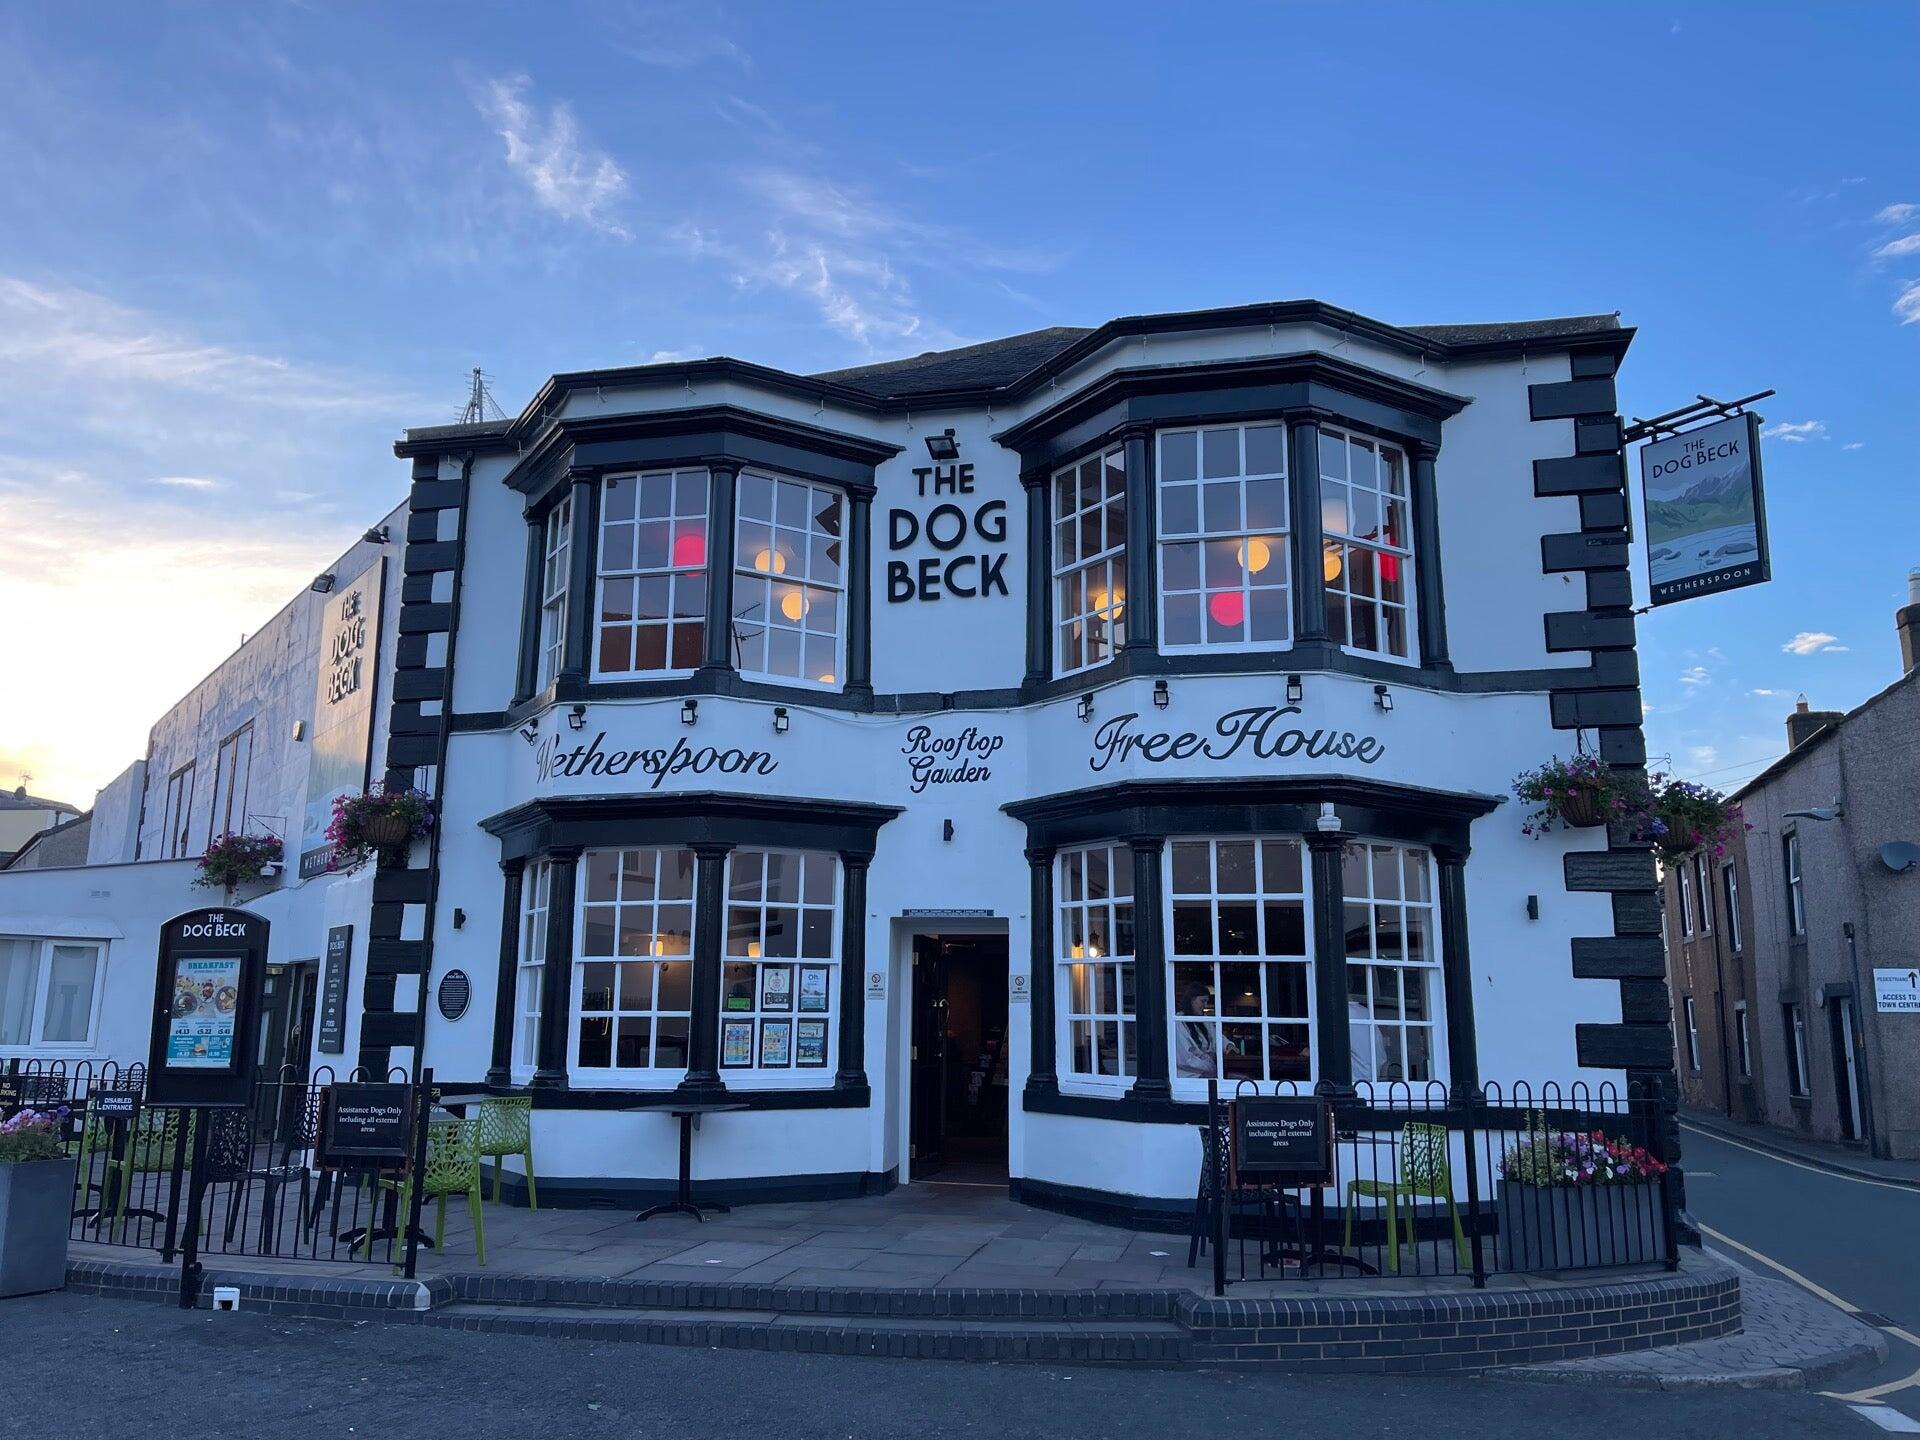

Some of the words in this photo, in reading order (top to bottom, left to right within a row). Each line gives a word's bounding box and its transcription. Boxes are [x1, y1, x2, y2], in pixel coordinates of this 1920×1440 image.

[1653, 455, 1692, 478] DOG
[1697, 440, 1739, 466] BECK
[1683, 438, 1705, 453] THE
[912, 463, 974, 496] THE
[889, 500, 1006, 551] DOG
[888, 553, 1009, 603] BECK
[1660, 568, 1751, 595] WETHERSPOON
[331, 617, 366, 666] DOG
[327, 656, 361, 705] BECK
[901, 725, 1004, 760] Rooftop
[1089, 713, 1206, 772] Free
[1203, 706, 1385, 764] House
[536, 731, 779, 789] Wetherspoon
[908, 755, 992, 793] Garden
[183, 924, 212, 938] DOG
[215, 923, 247, 937] BECK
[208, 913, 224, 923] THE
[188, 961, 235, 969] BREAKFAST
[1882, 993, 1906, 1001] ACCESS
[0, 1089, 17, 1097] RKING
[337, 1106, 369, 1114] Assistance
[370, 1106, 386, 1116] Dogs
[387, 1106, 402, 1116] Only
[339, 1116, 366, 1125] including
[375, 1116, 399, 1124] external
[1246, 1119, 1280, 1127] Assistance
[1280, 1119, 1298, 1129] Dogs
[1298, 1119, 1314, 1129] Only
[1248, 1130, 1277, 1139] including
